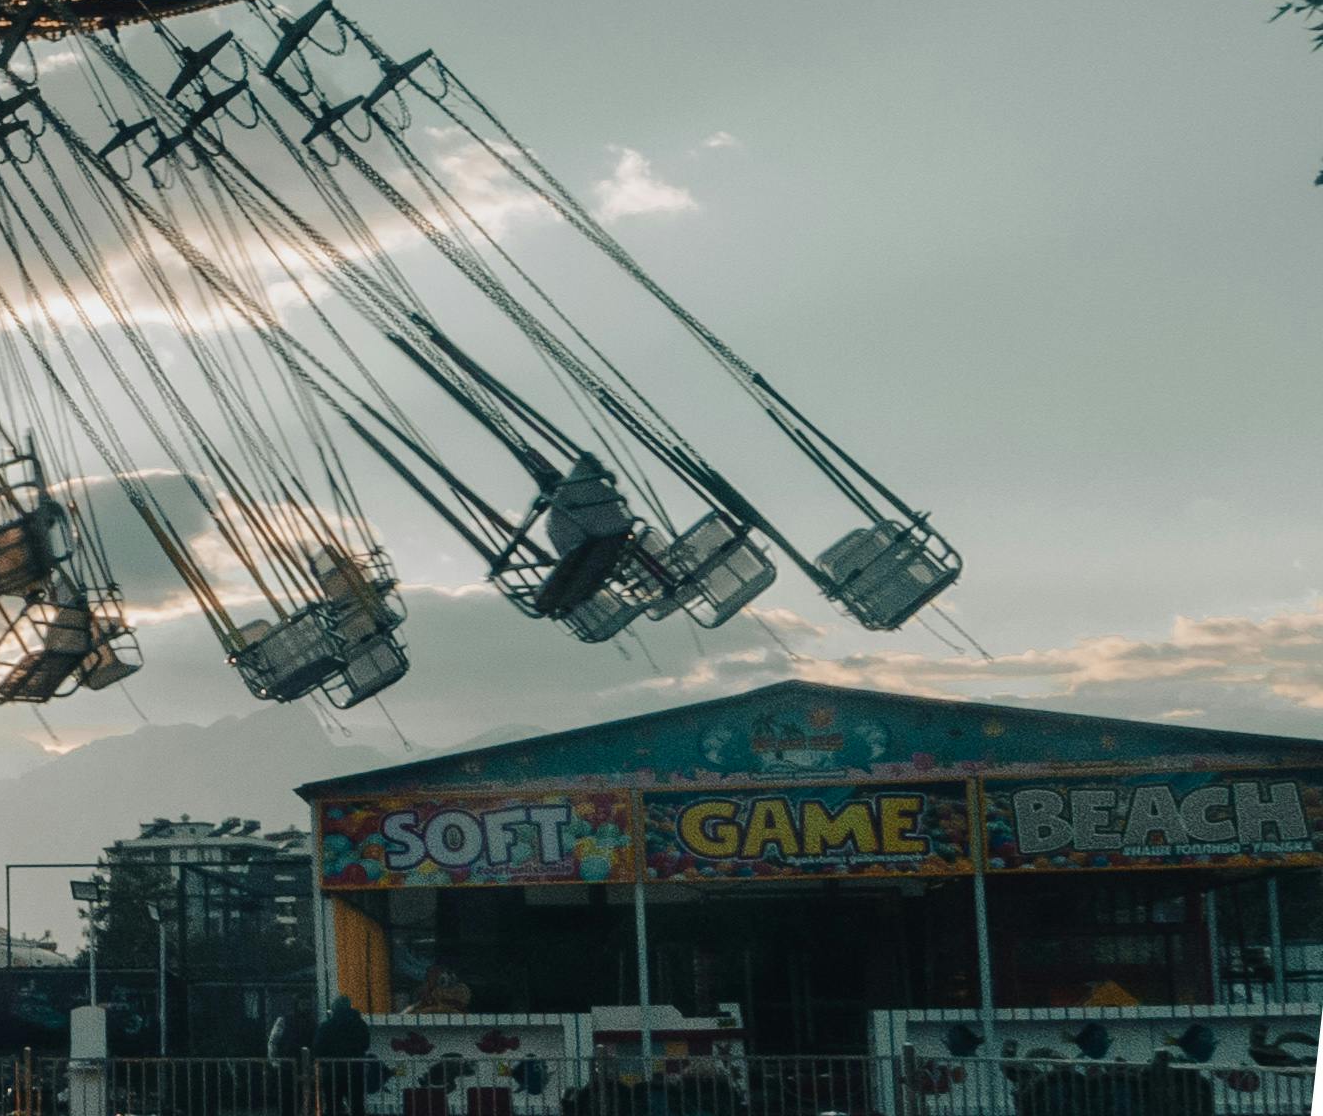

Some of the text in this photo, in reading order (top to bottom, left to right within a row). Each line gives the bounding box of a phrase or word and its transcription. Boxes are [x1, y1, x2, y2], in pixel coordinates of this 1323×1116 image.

[381, 804, 571, 871] SOFT
[677, 793, 931, 860] GAME
[1012, 781, 1308, 854] BEACH
